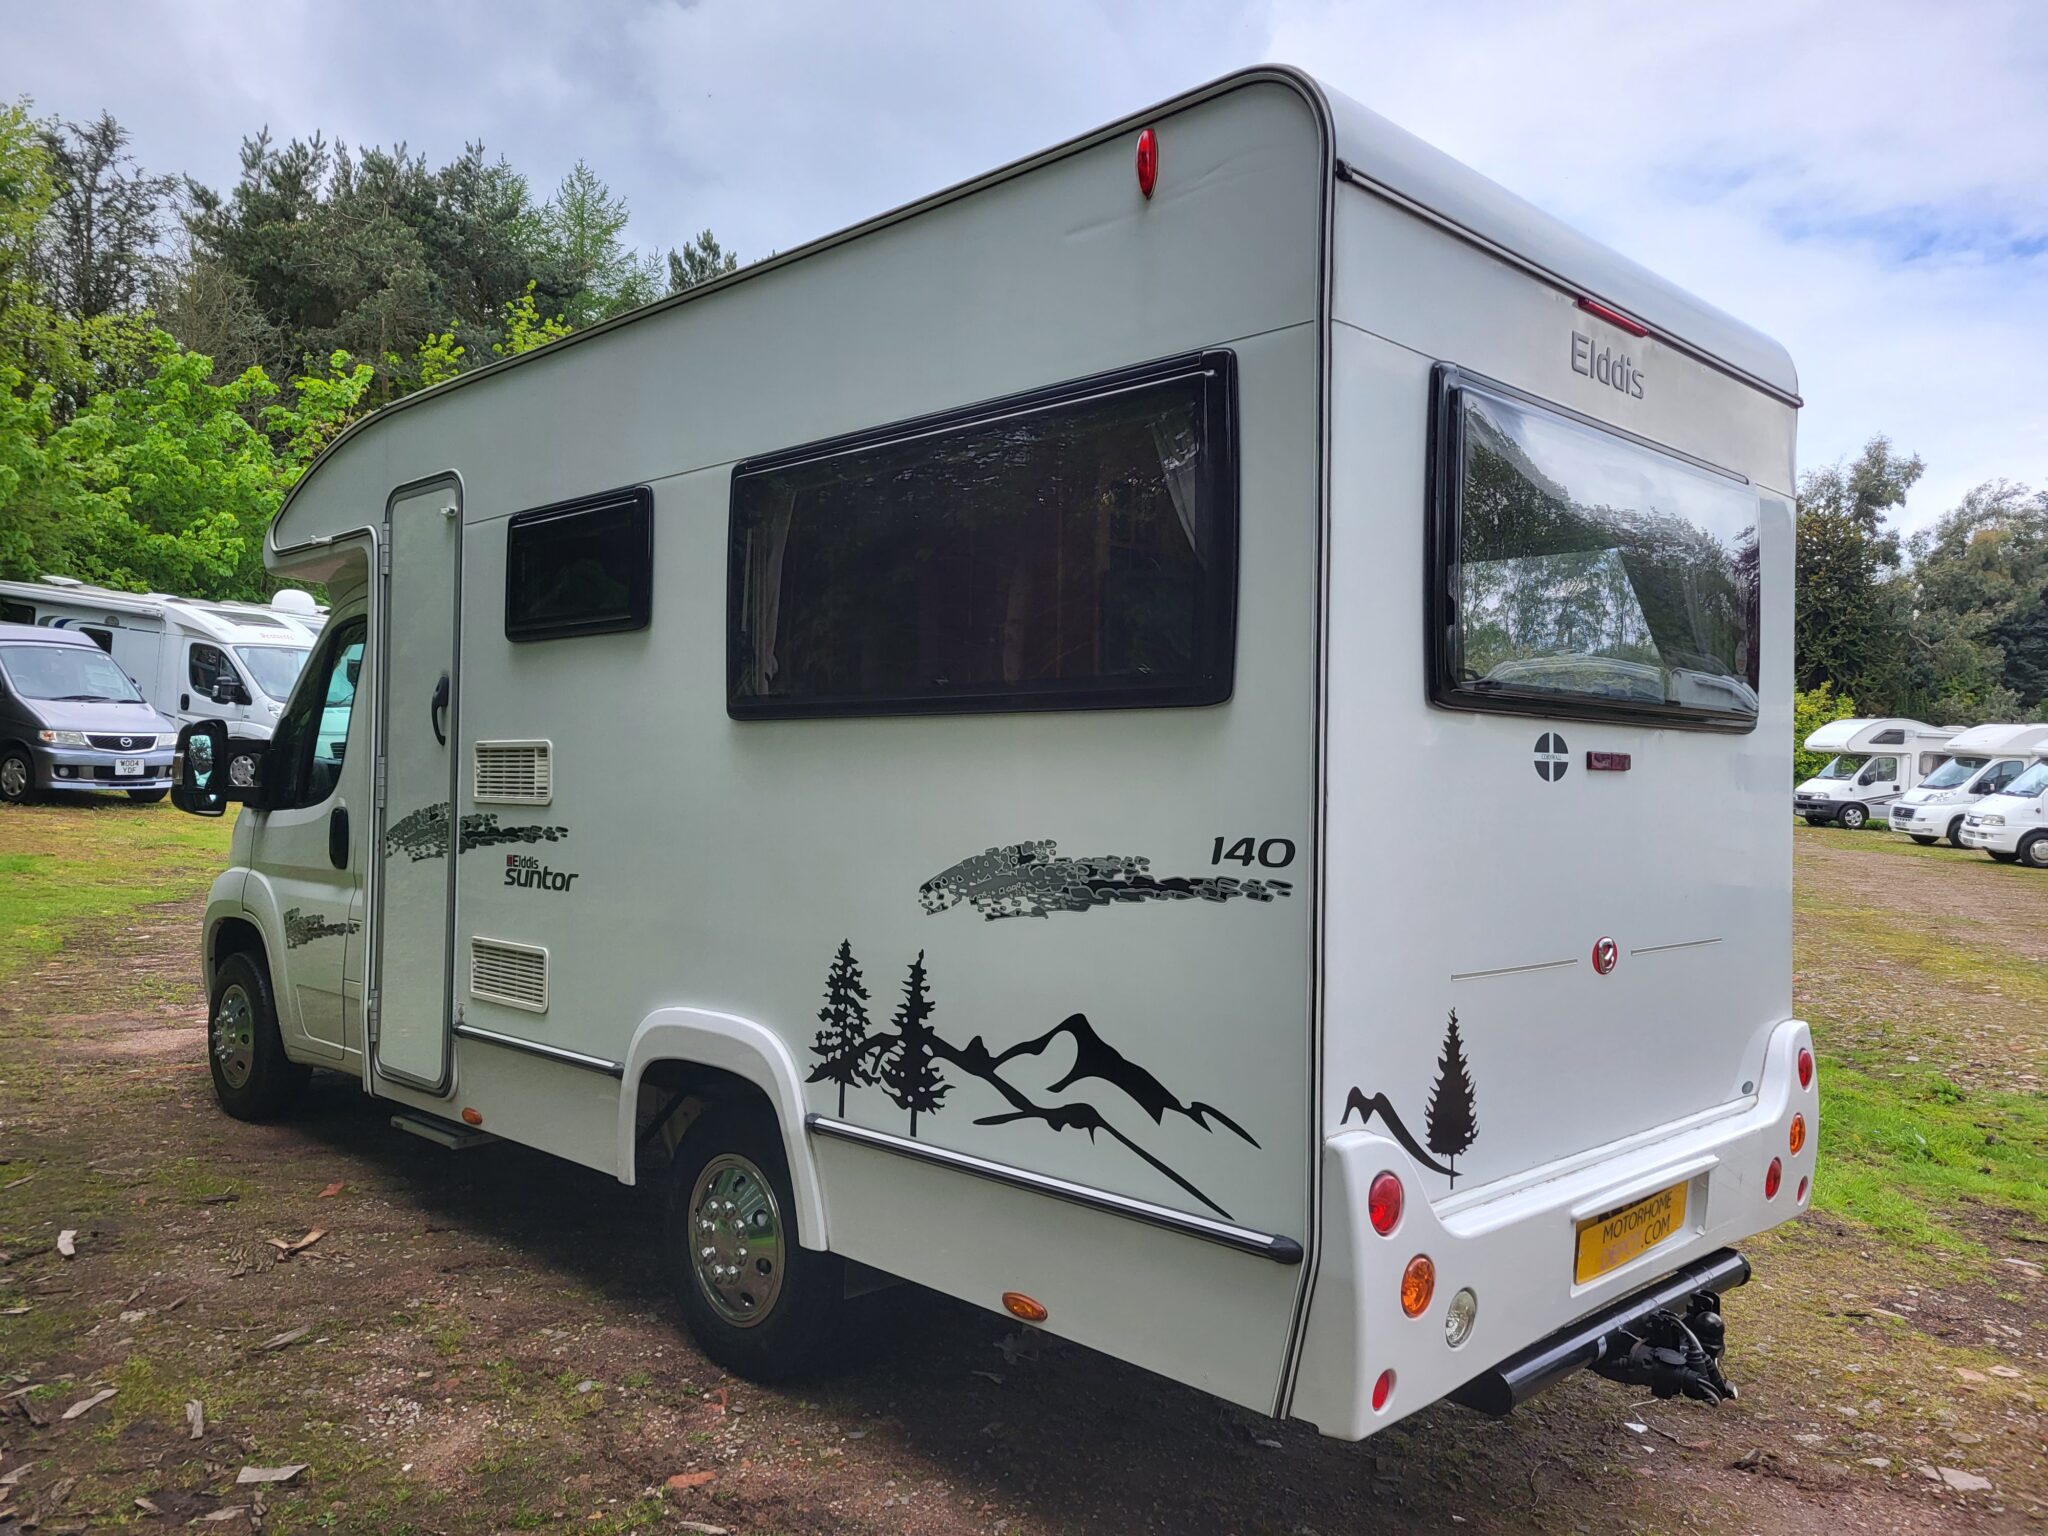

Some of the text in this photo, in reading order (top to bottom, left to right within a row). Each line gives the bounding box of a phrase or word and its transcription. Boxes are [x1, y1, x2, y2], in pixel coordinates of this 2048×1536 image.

[1571, 330, 1645, 399] Elddis
[512, 854, 539, 869] Elddis
[1211, 836, 1296, 868] 140
[504, 866, 579, 892] suntor
[1602, 1190, 1672, 1244] MOTORHOME
